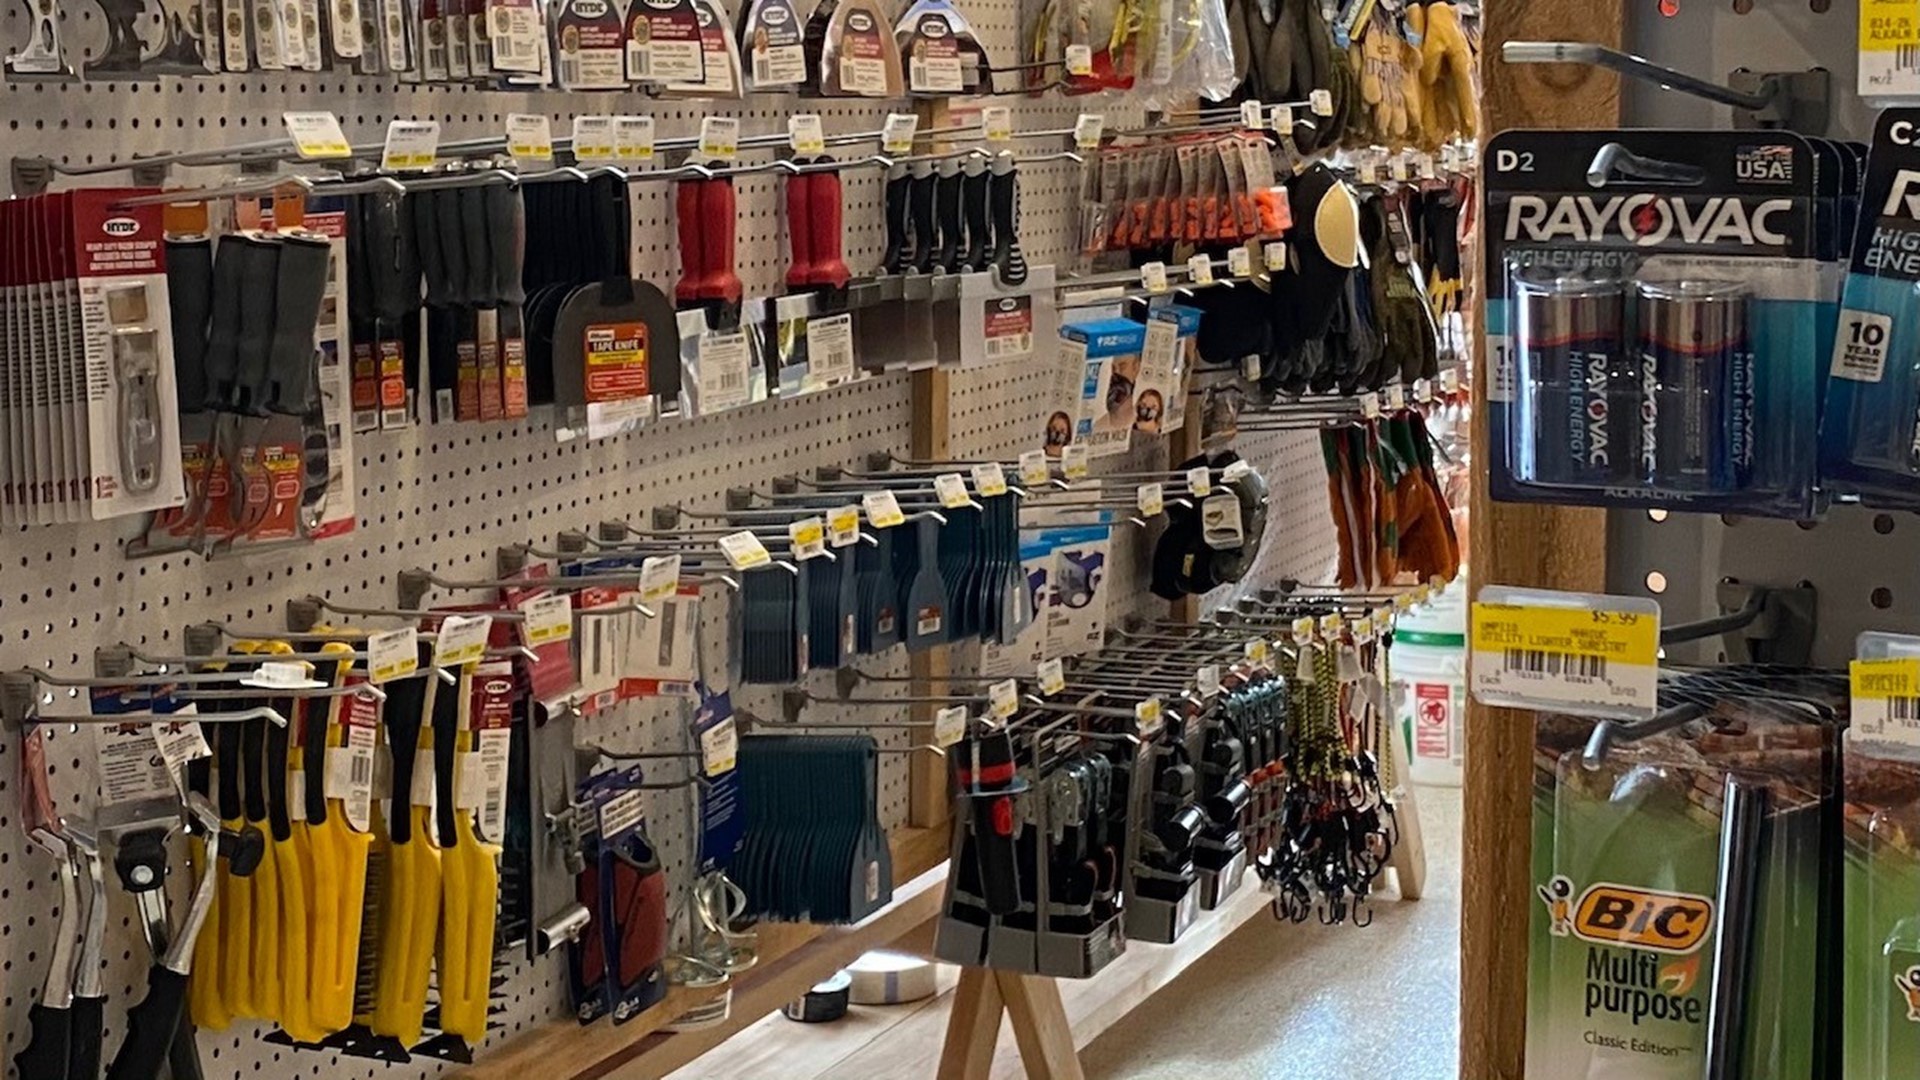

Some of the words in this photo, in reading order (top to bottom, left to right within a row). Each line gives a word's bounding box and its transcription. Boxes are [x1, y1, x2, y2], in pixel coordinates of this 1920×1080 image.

[1736, 160, 1786, 179] USA
[106, 222, 136, 232] HYDE
[1503, 193, 1793, 247] RAYOVAC
[1871, 226, 1920, 252] HIG
[1553, 249, 1631, 268] ENERGY
[1864, 247, 1920, 275] ENE
[614, 339, 639, 350] KNIFE
[1849, 321, 1884, 346] 10
[1846, 344, 1881, 358] YEAR
[1569, 351, 1583, 394] HIGH
[1587, 353, 1609, 467] RAYOVAC
[1569, 396, 1584, 464] ENERGY
[1480, 631, 1523, 643] UTILITY
[1529, 635, 1573, 647] LIGHTER
[1586, 946, 1659, 989] Multi
[1585, 983, 1701, 1026] purpose
[1583, 1030, 1627, 1050] Classic
